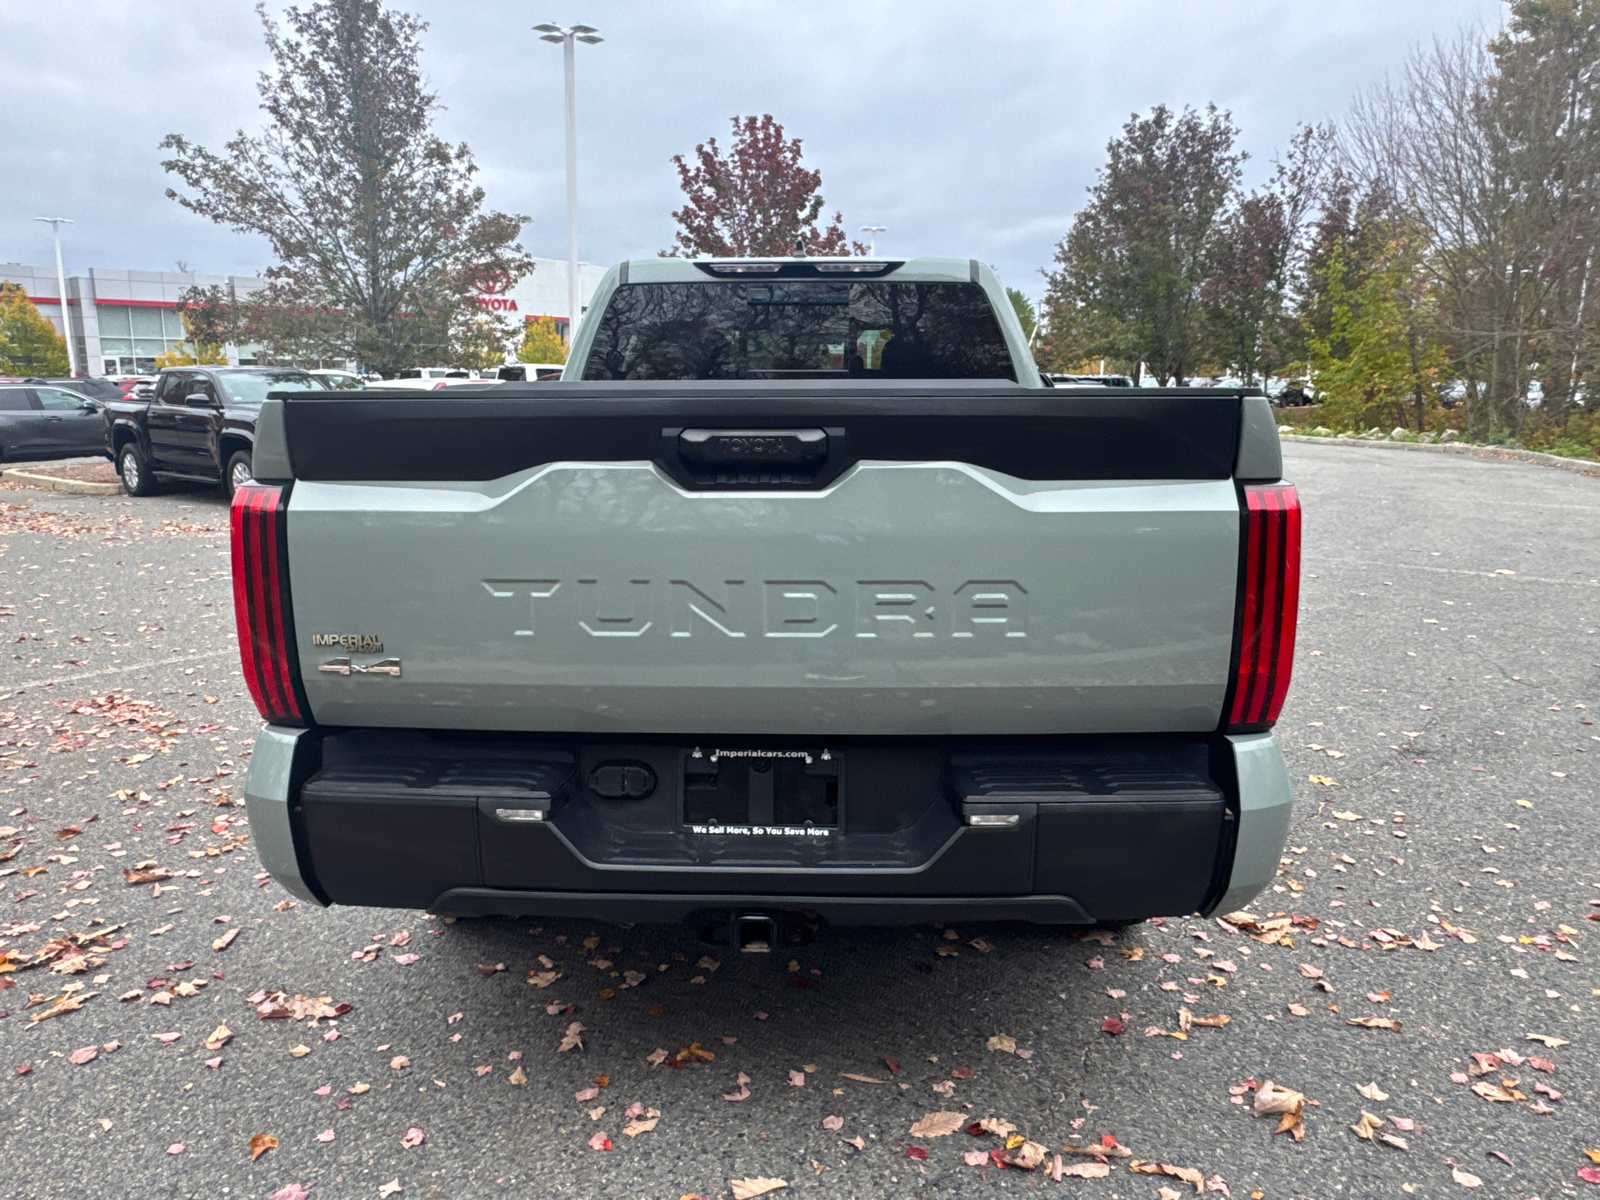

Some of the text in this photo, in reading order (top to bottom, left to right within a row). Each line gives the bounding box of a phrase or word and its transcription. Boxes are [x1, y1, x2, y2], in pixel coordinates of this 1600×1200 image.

[719, 438, 787, 453] TOYOTA
[481, 579, 1028, 638] TUNDRA
[312, 634, 381, 645] IMPERIAL
[715, 749, 808, 758] Imperialcars.com
[692, 826, 830, 836] We Sell More, So You Save More
